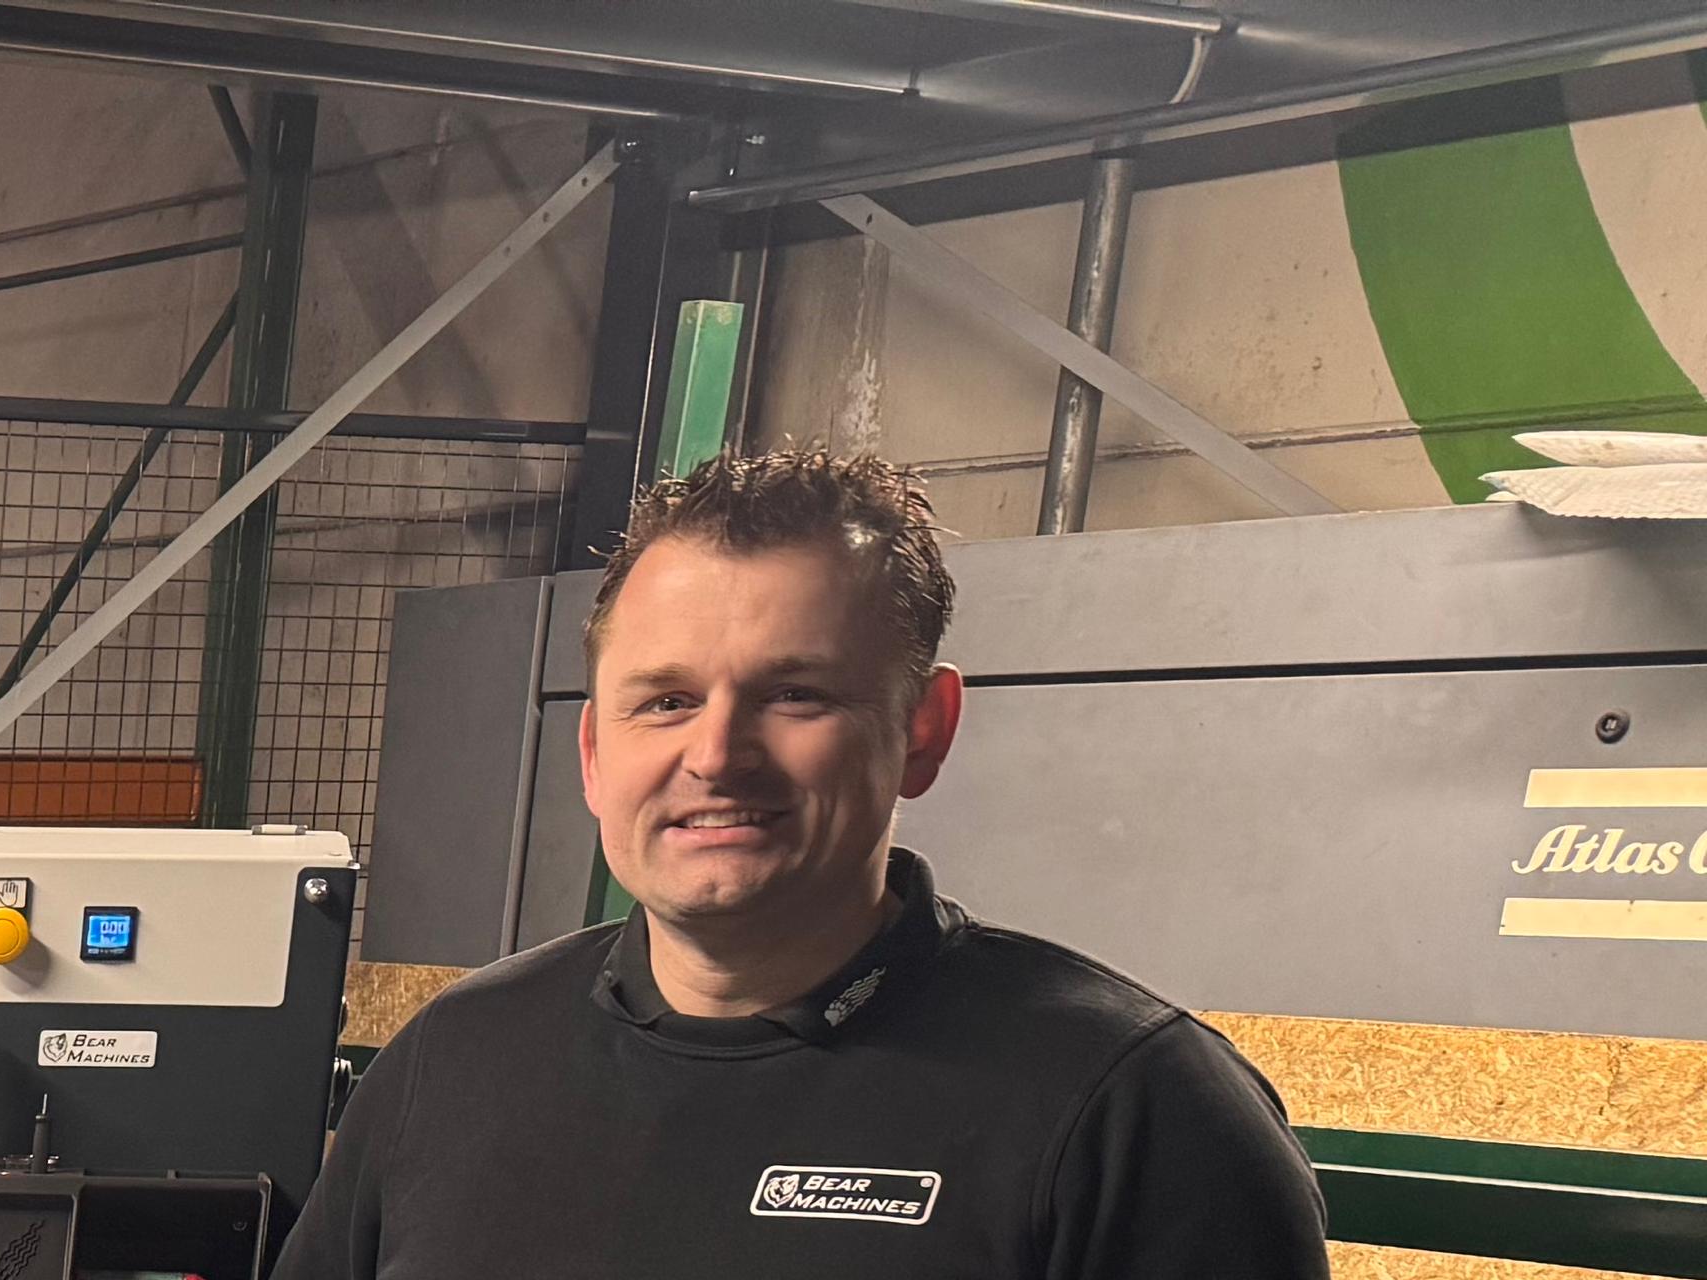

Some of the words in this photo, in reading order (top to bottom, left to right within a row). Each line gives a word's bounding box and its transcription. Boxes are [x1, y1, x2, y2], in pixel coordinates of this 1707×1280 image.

[1511, 824, 1685, 875] Atlas
[73, 1034, 117, 1047] BEAR
[66, 1050, 151, 1063] MACHINES
[802, 1175, 872, 1193] BEAR
[788, 1193, 922, 1215] MACHINES
